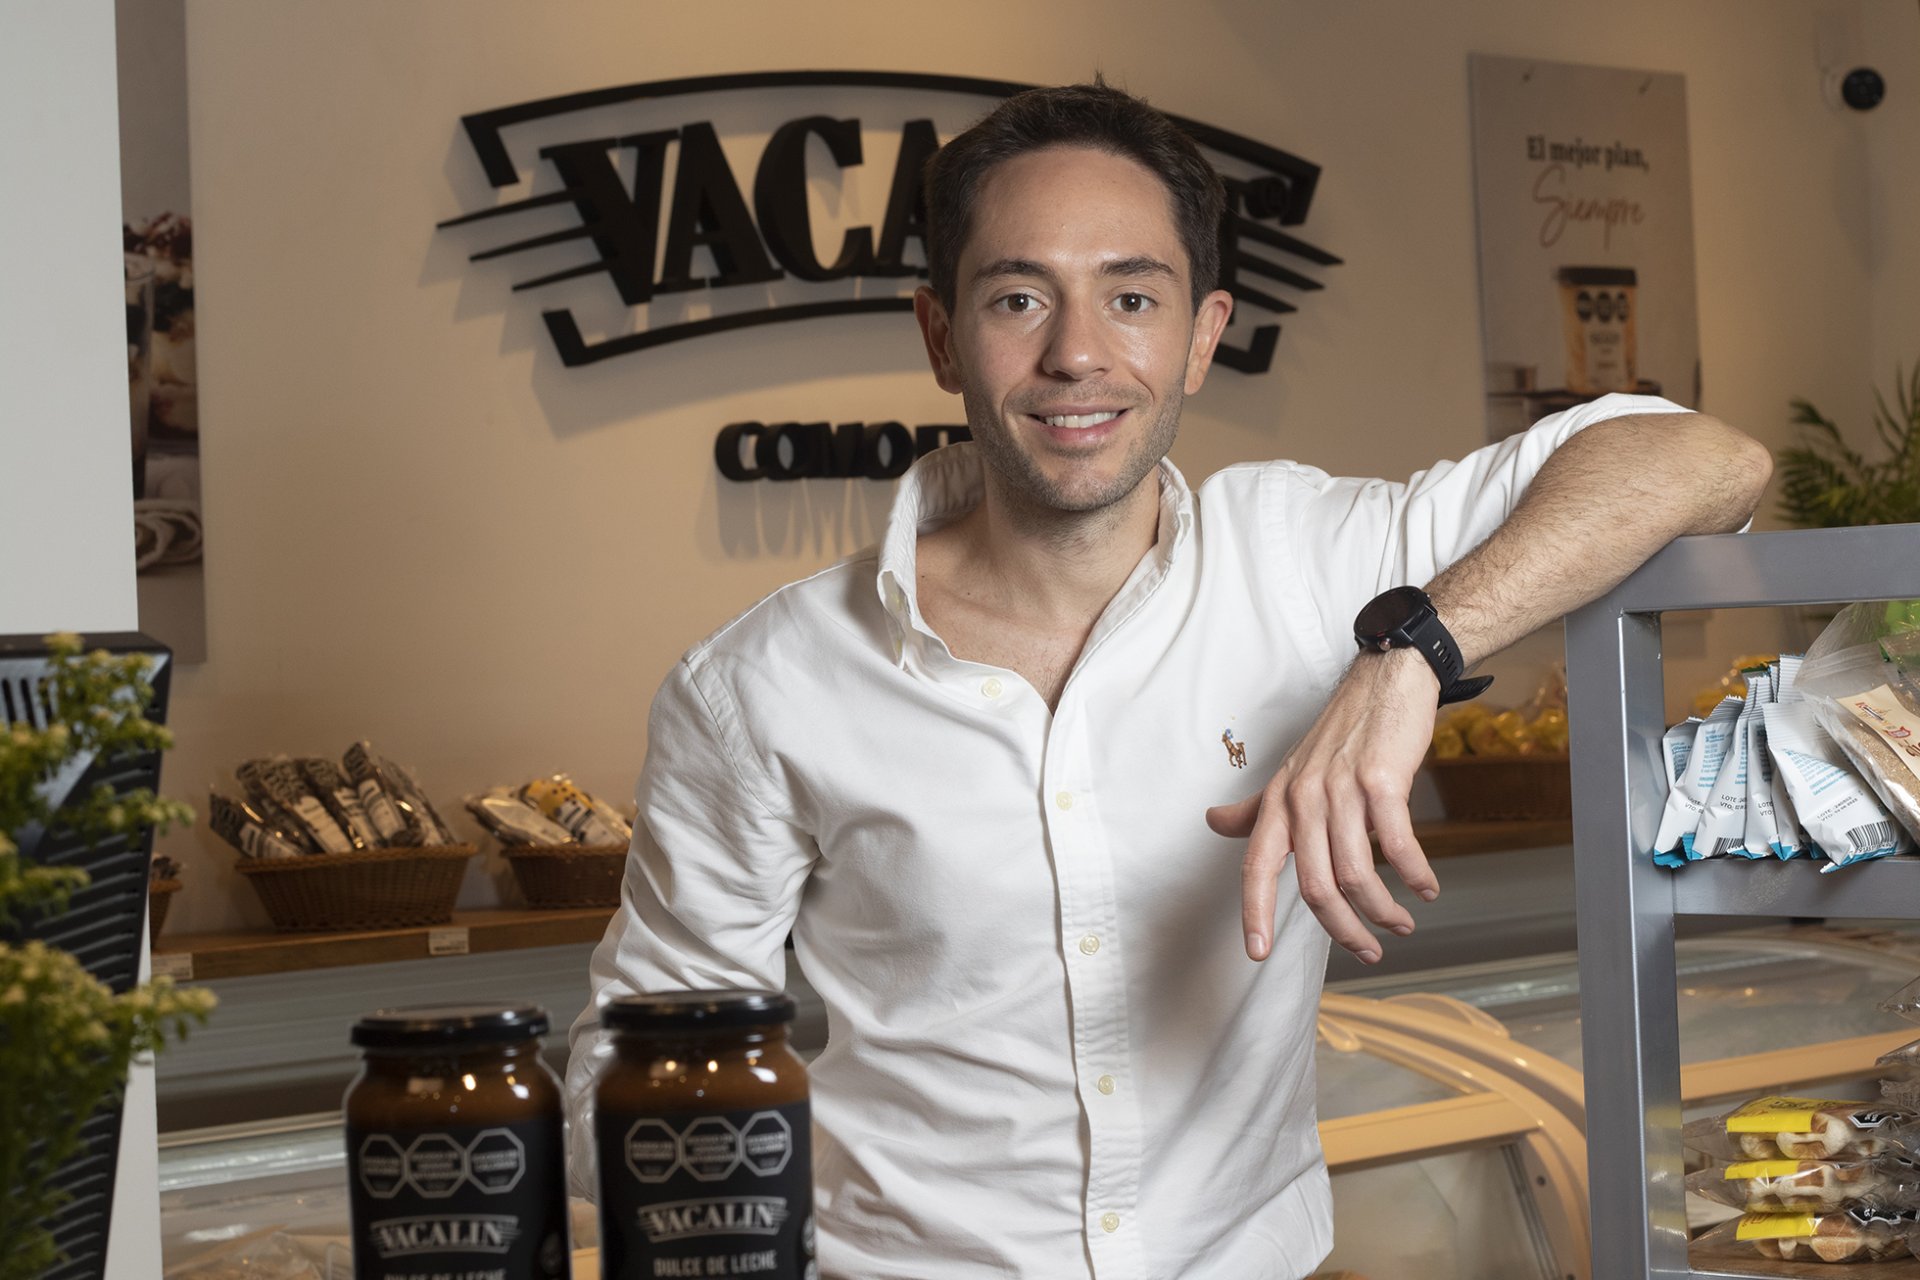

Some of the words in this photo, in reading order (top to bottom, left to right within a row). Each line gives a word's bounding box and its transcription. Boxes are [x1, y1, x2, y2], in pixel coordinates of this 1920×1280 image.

[1526, 134, 1545, 160] El
[1550, 138, 1601, 168] mejor
[539, 115, 937, 306] VACA
[1532, 163, 1644, 251] Siempre
[379, 1220, 503, 1248] VACALIN
[650, 1203, 773, 1233] VACALIN
[654, 1257, 700, 1277] DULCE
[706, 1255, 728, 1275] DE
[731, 1249, 777, 1273] LECHE
